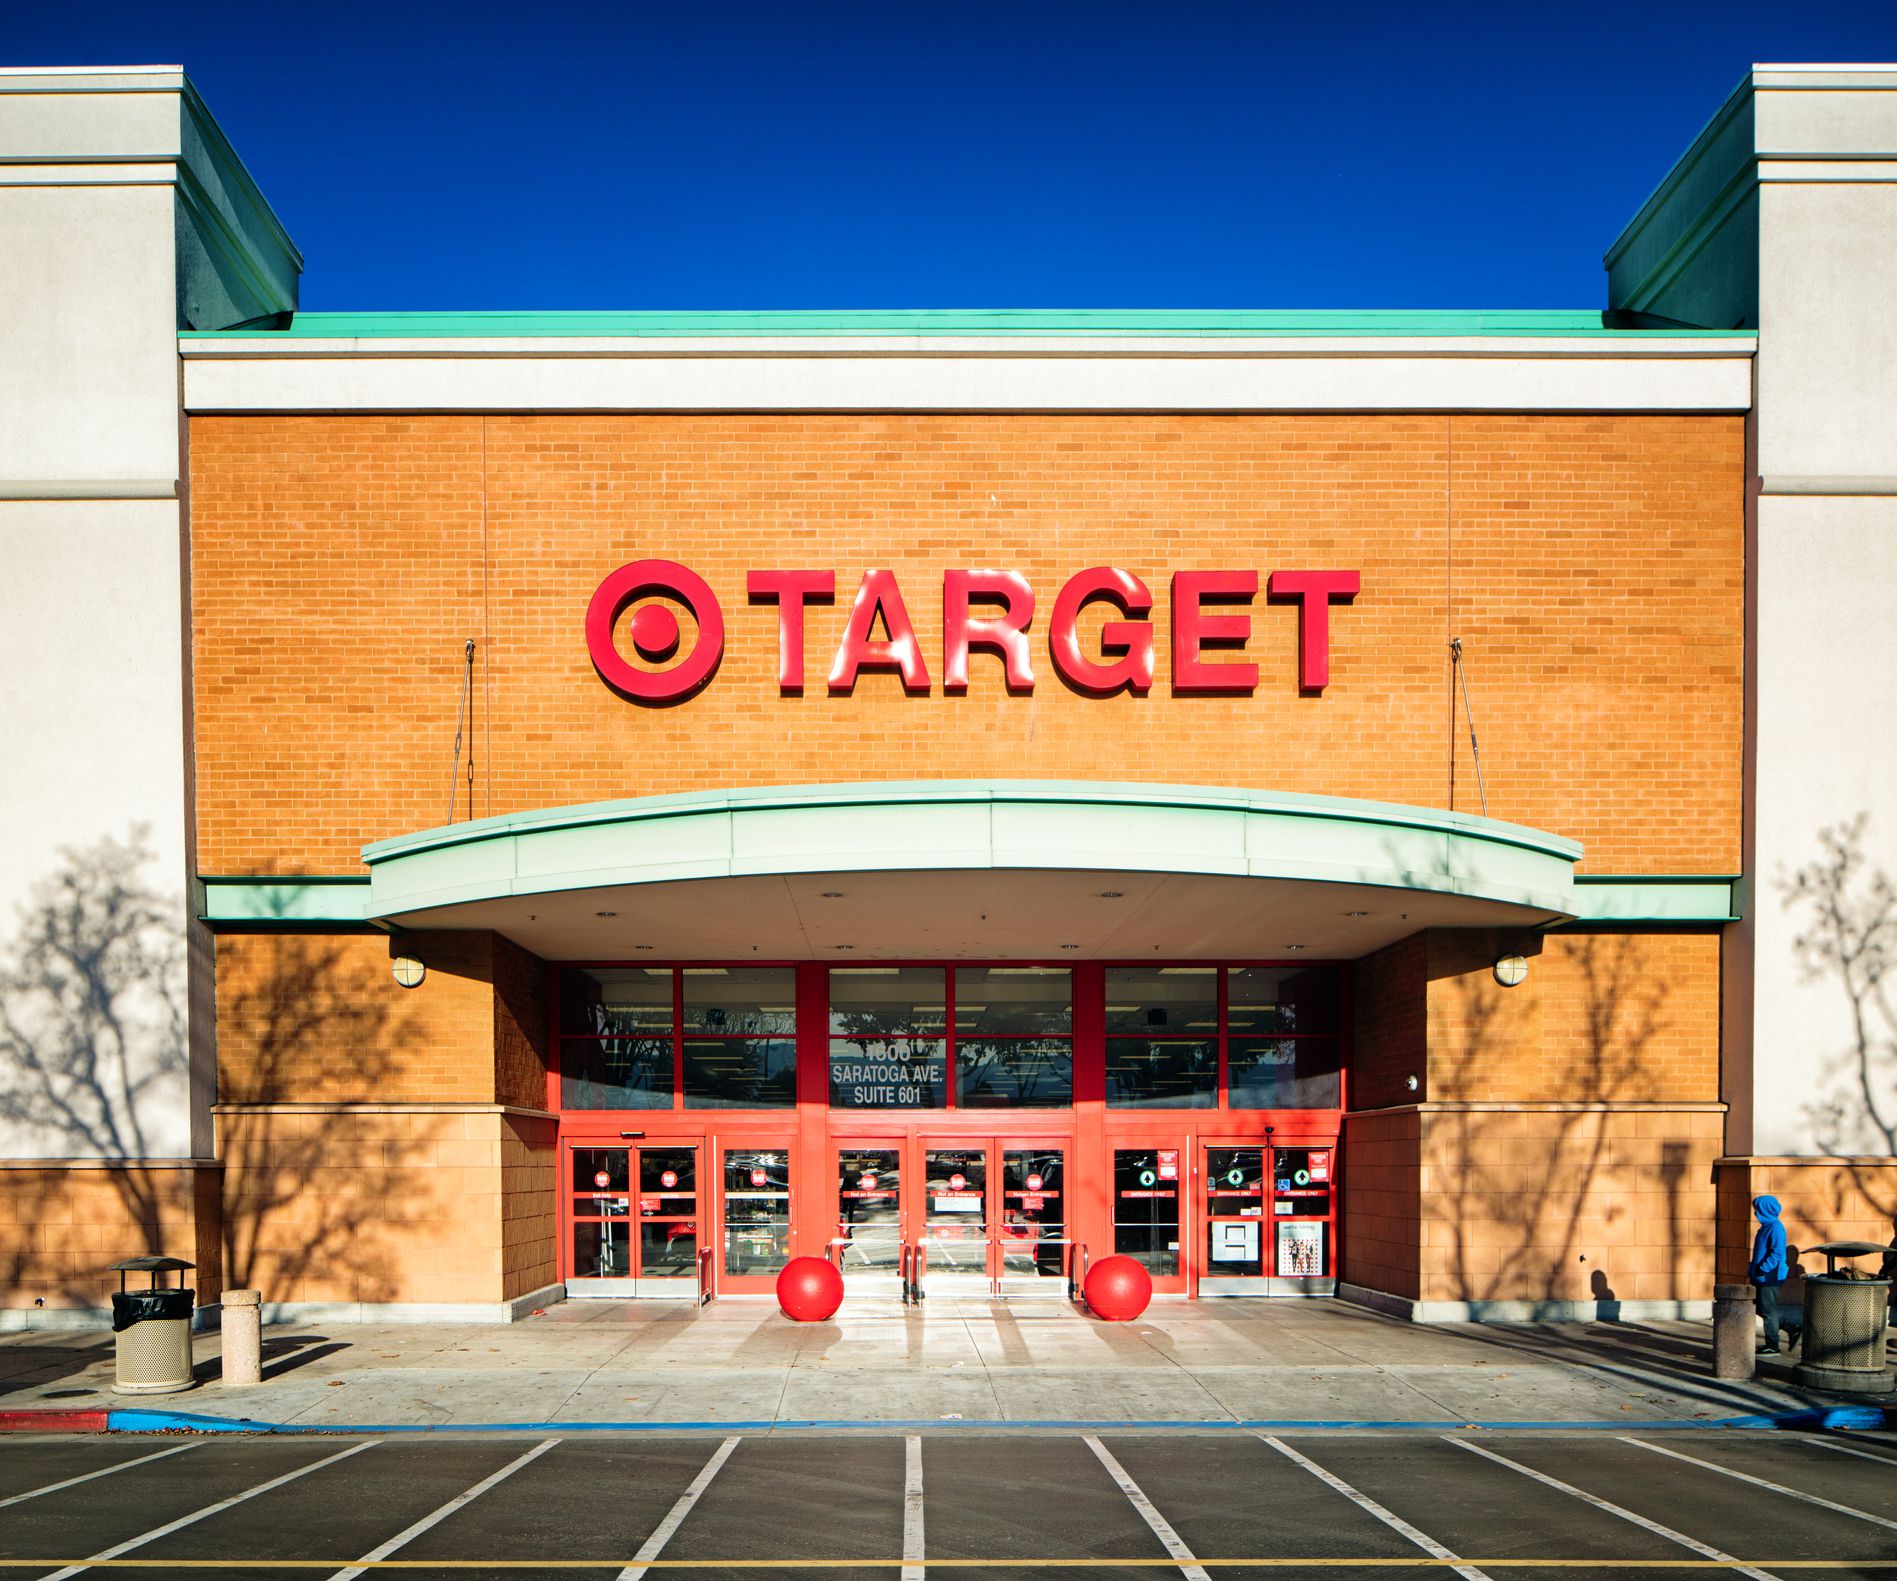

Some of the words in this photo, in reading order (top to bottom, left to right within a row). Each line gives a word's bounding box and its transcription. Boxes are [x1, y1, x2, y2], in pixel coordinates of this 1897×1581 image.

[746, 566, 1361, 698] TARGET
[833, 1065, 908, 1082] SARATOGA
[912, 1065, 943, 1082] AVE.
[854, 1086, 895, 1104] SUITE
[898, 1086, 920, 1104] 601
